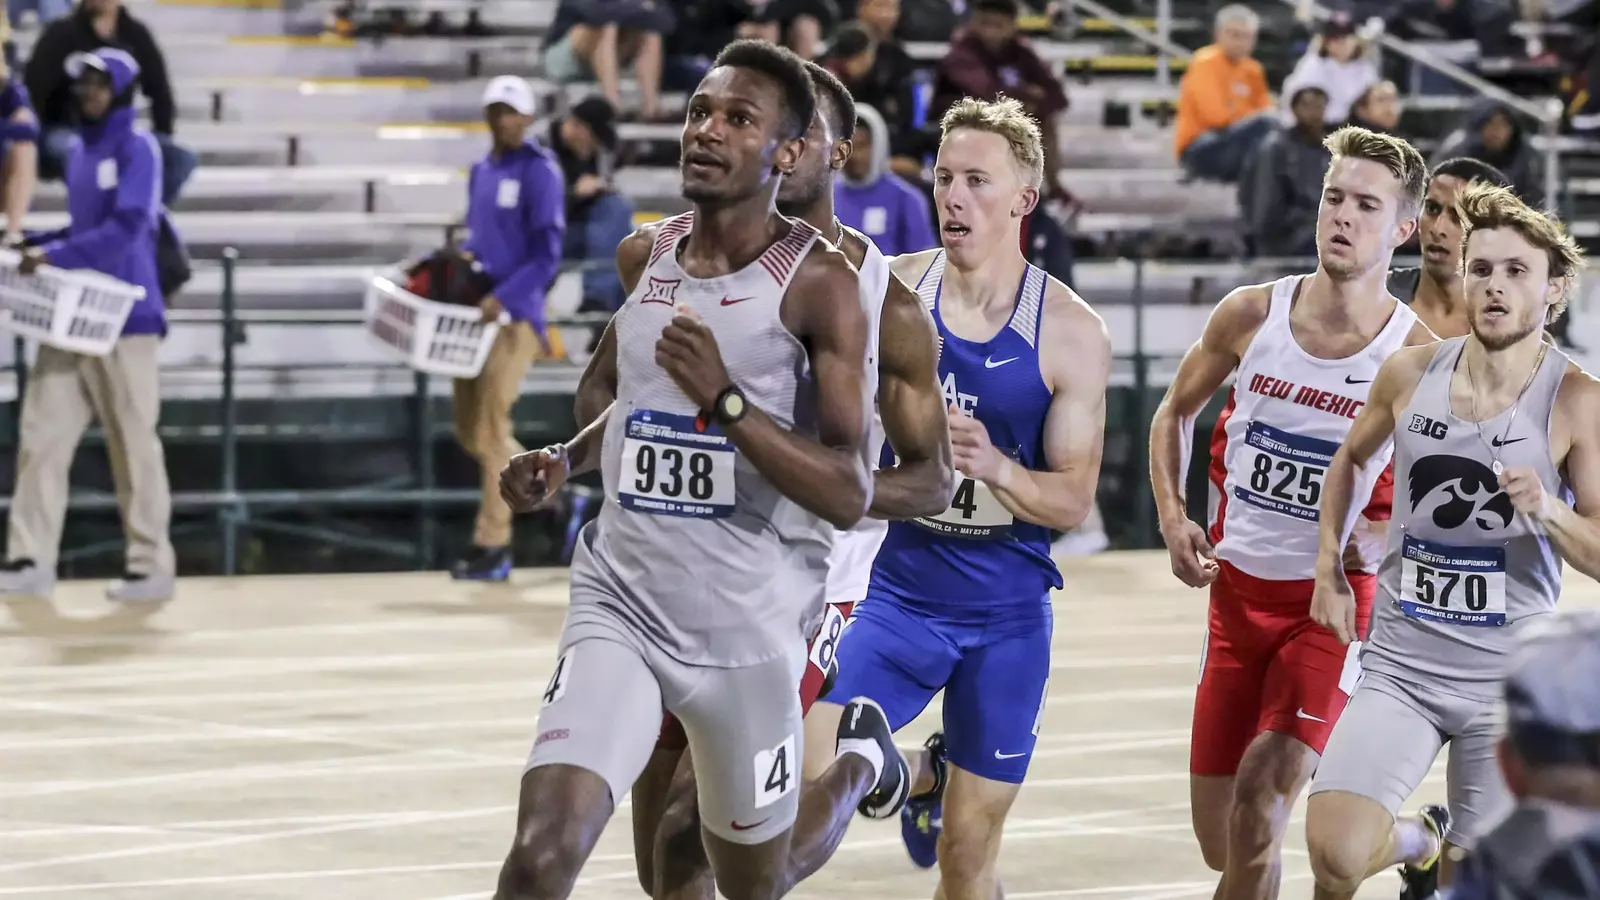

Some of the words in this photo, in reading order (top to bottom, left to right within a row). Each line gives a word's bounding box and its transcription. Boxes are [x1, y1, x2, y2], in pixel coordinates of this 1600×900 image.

[1249, 373, 1294, 401] NEW
[1293, 385, 1365, 420] MEXIC
[635, 444, 713, 501] 938
[1260, 438, 1275, 449] TRACK
[1278, 445, 1292, 454] FIELD
[1292, 449, 1334, 461] CHAMPIONSHIP
[1250, 452, 1324, 507] 825
[943, 524, 952, 532] CA
[960, 527, 973, 535] MAY
[973, 528, 990, 536] 23-25
[1290, 505, 1301, 514] MAY
[1416, 550, 1431, 561] TRACK
[1436, 556, 1451, 565] FIELD
[1451, 558, 1498, 567] CHAMPIONSHIPS
[1415, 564, 1488, 612] 570
[1415, 606, 1447, 619] SACRAMENTO,
[819, 614, 842, 670] 8
[543, 656, 566, 704] 4
[764, 744, 791, 794] 4
